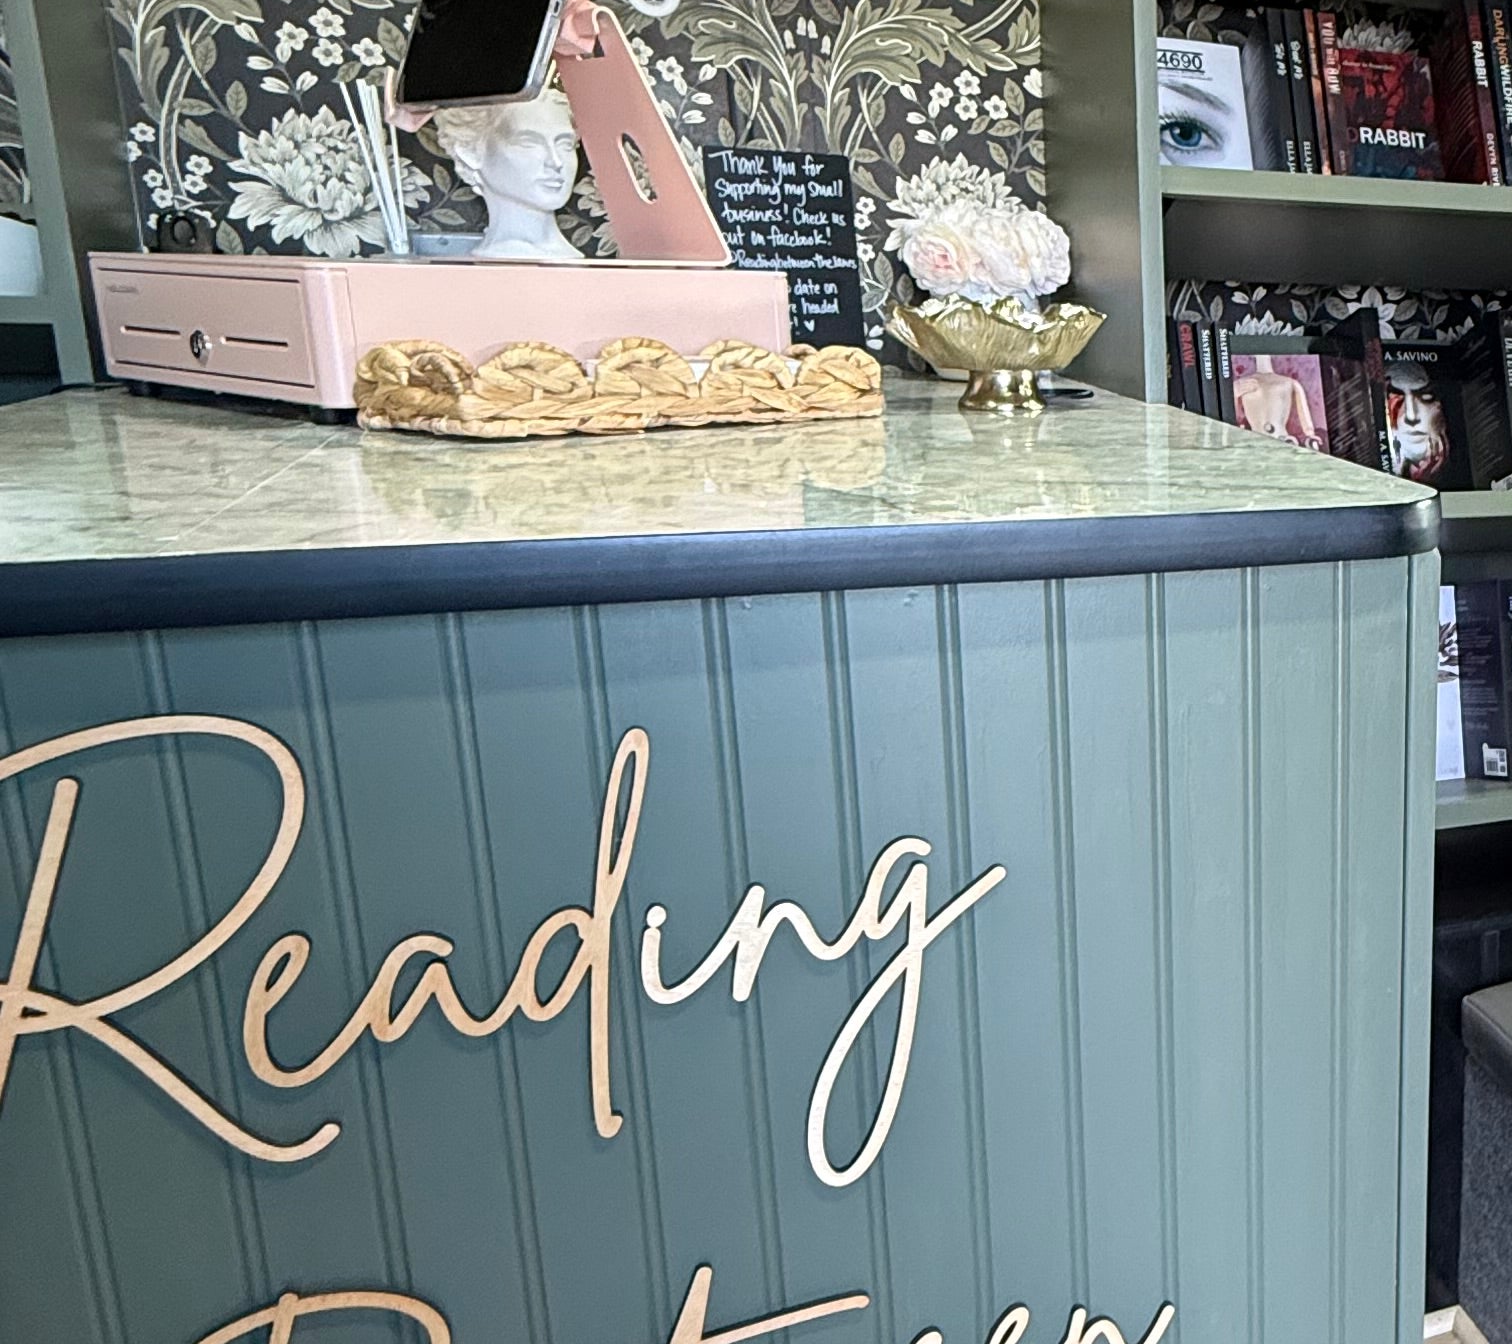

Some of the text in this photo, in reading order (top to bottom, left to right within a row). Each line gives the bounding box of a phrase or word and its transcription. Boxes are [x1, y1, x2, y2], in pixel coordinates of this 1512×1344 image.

[1472, 40, 1488, 88] RABBIT
[1359, 126, 1427, 150] RABBIT
[708, 150, 769, 176] Thank
[802, 156, 825, 176] for
[784, 182, 806, 207] my
[793, 208, 828, 225] Check
[831, 212, 846, 226] us
[751, 233, 766, 247] on
[794, 278, 838, 296] date on
[801, 298, 840, 315] headed
[1179, 323, 1197, 368] CRAWL
[1396, 351, 1438, 363] SAVINO
[0, 714, 1006, 1187] Reading
